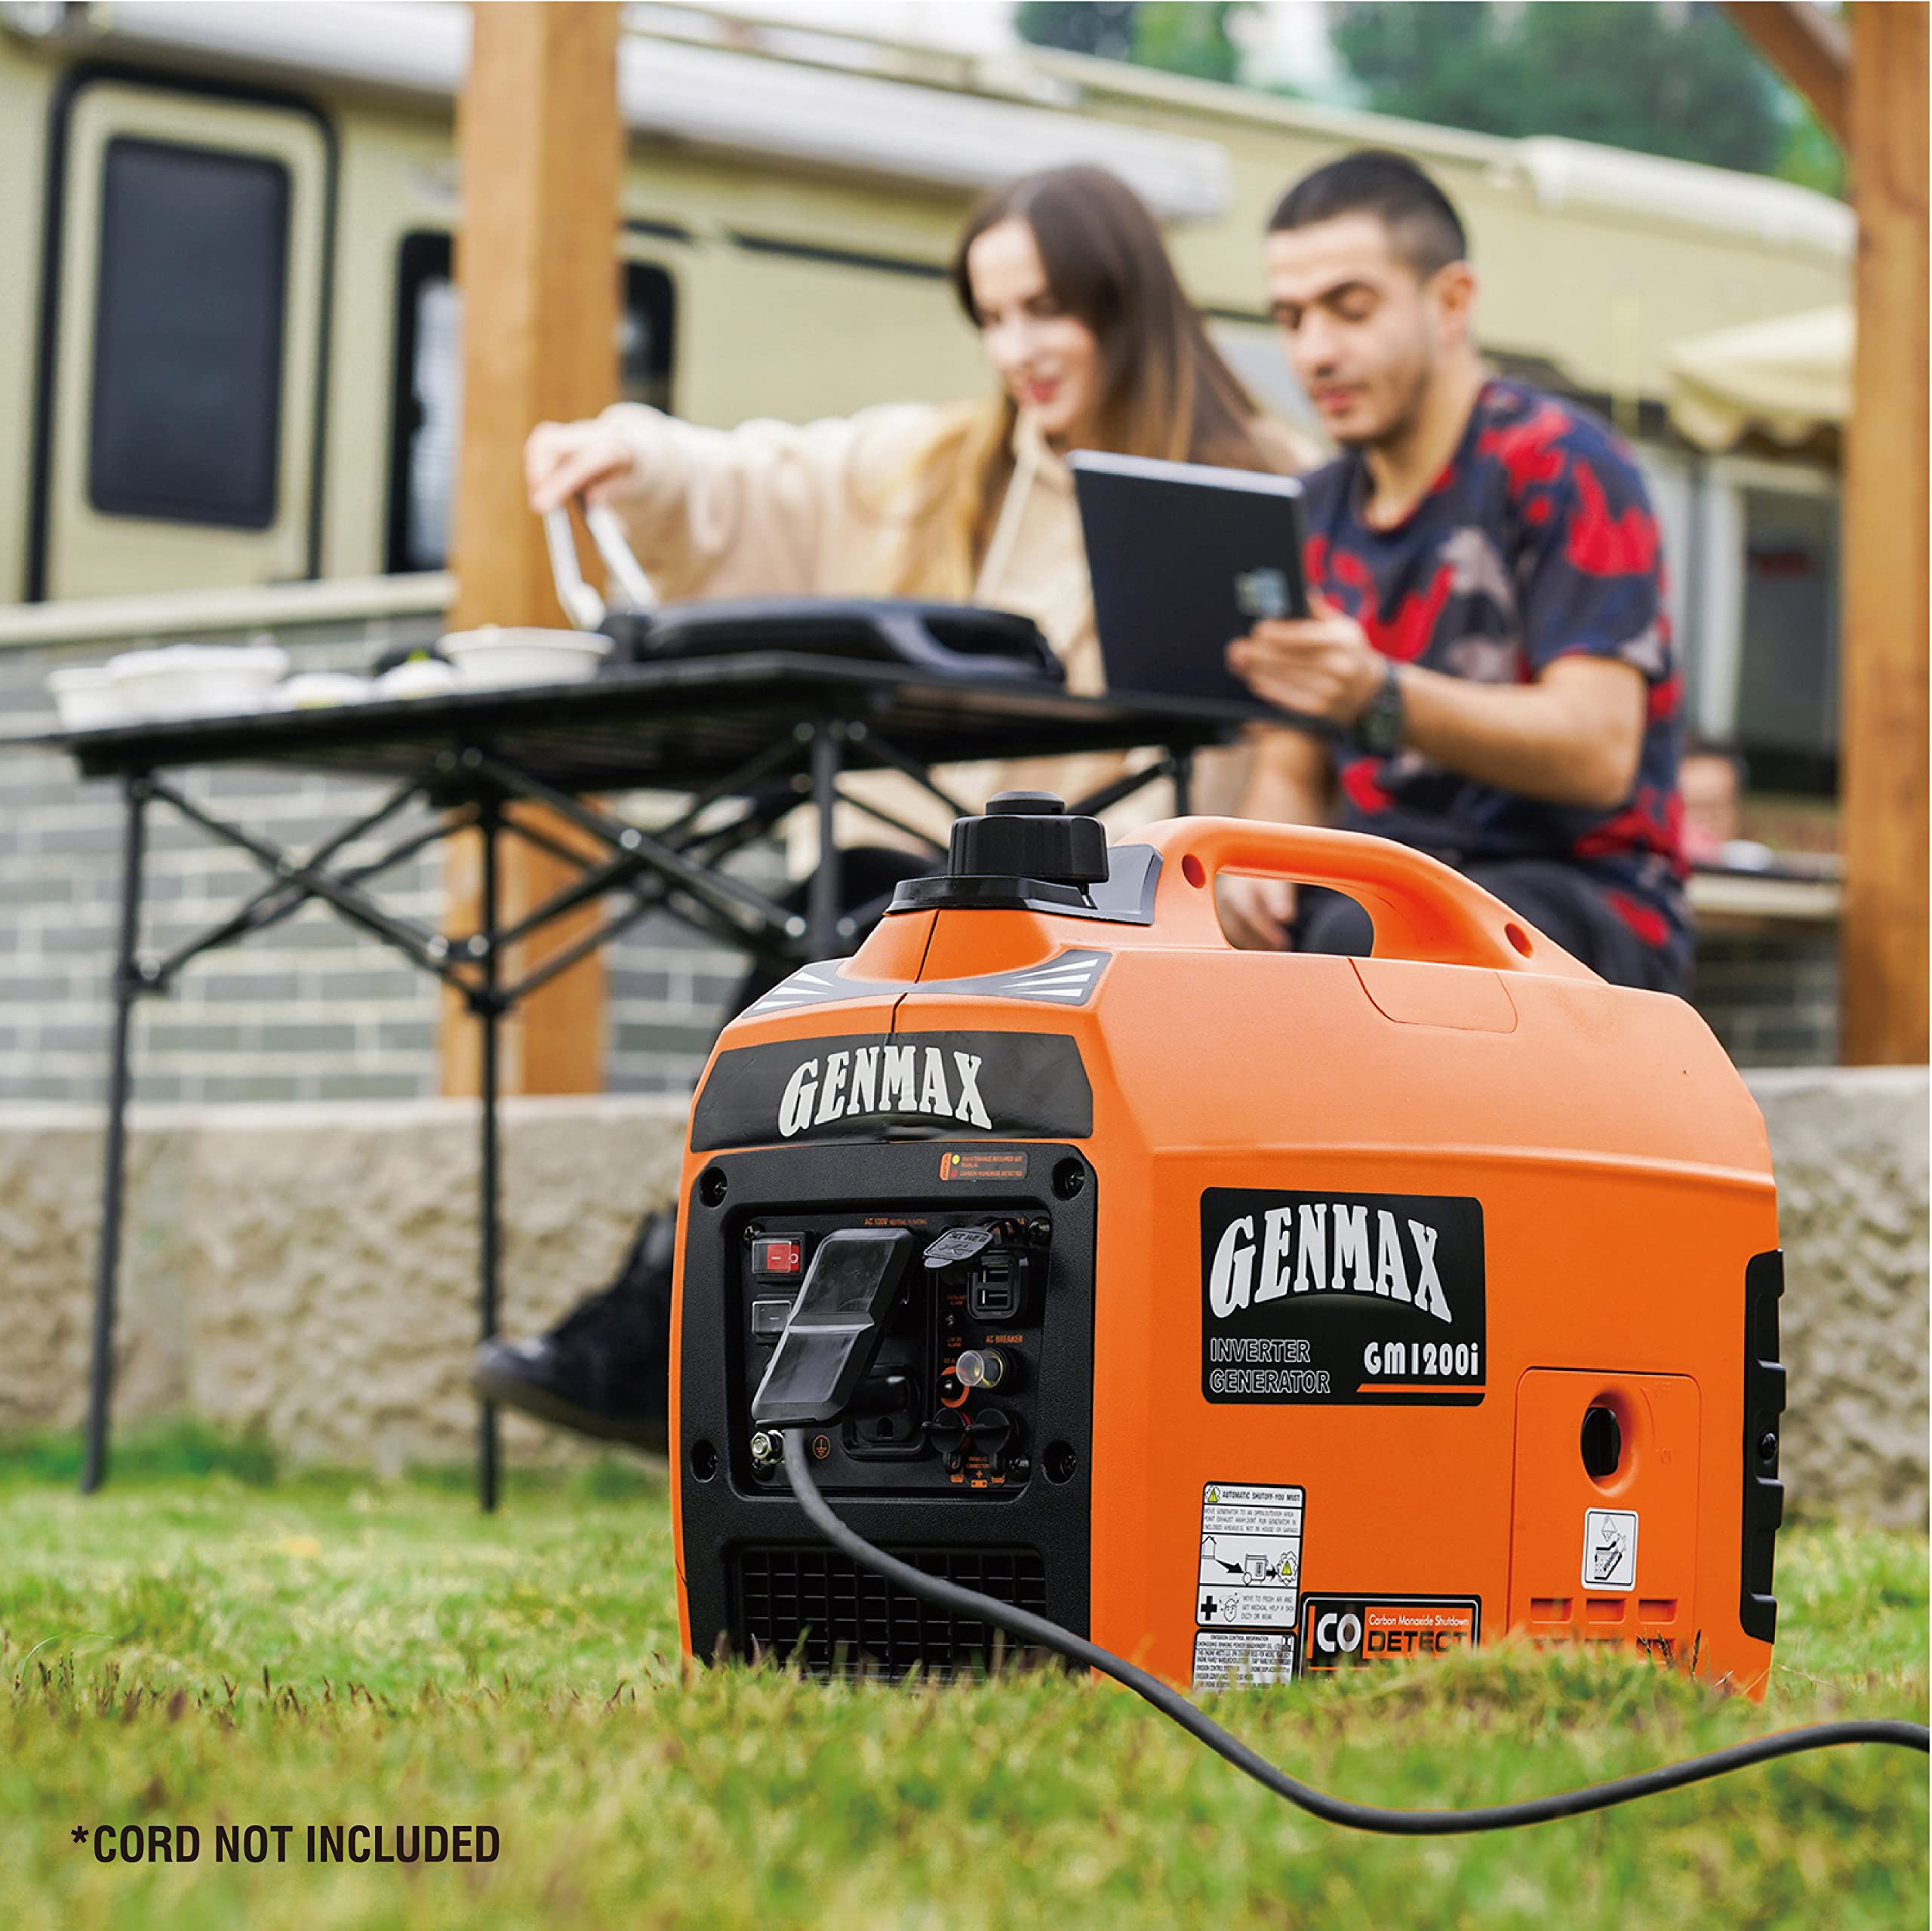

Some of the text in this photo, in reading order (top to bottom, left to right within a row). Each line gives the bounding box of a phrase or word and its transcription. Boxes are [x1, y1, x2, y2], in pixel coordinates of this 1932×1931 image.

[778, 1045, 992, 1137] GENMAX
[1209, 1203, 1453, 1324] GENMAX
[985, 1335, 1023, 1344] AC BREAKER
[1210, 1336, 1311, 1363] INVERTER
[1209, 1369, 1331, 1394] GENERATOR
[1222, 1491, 1251, 1499] AUTOMATIC
[1368, 1613, 1469, 1626] Carbon Monoxide Shutdown
[1317, 1613, 1361, 1653] CO
[1367, 1630, 1468, 1653] DETECT
